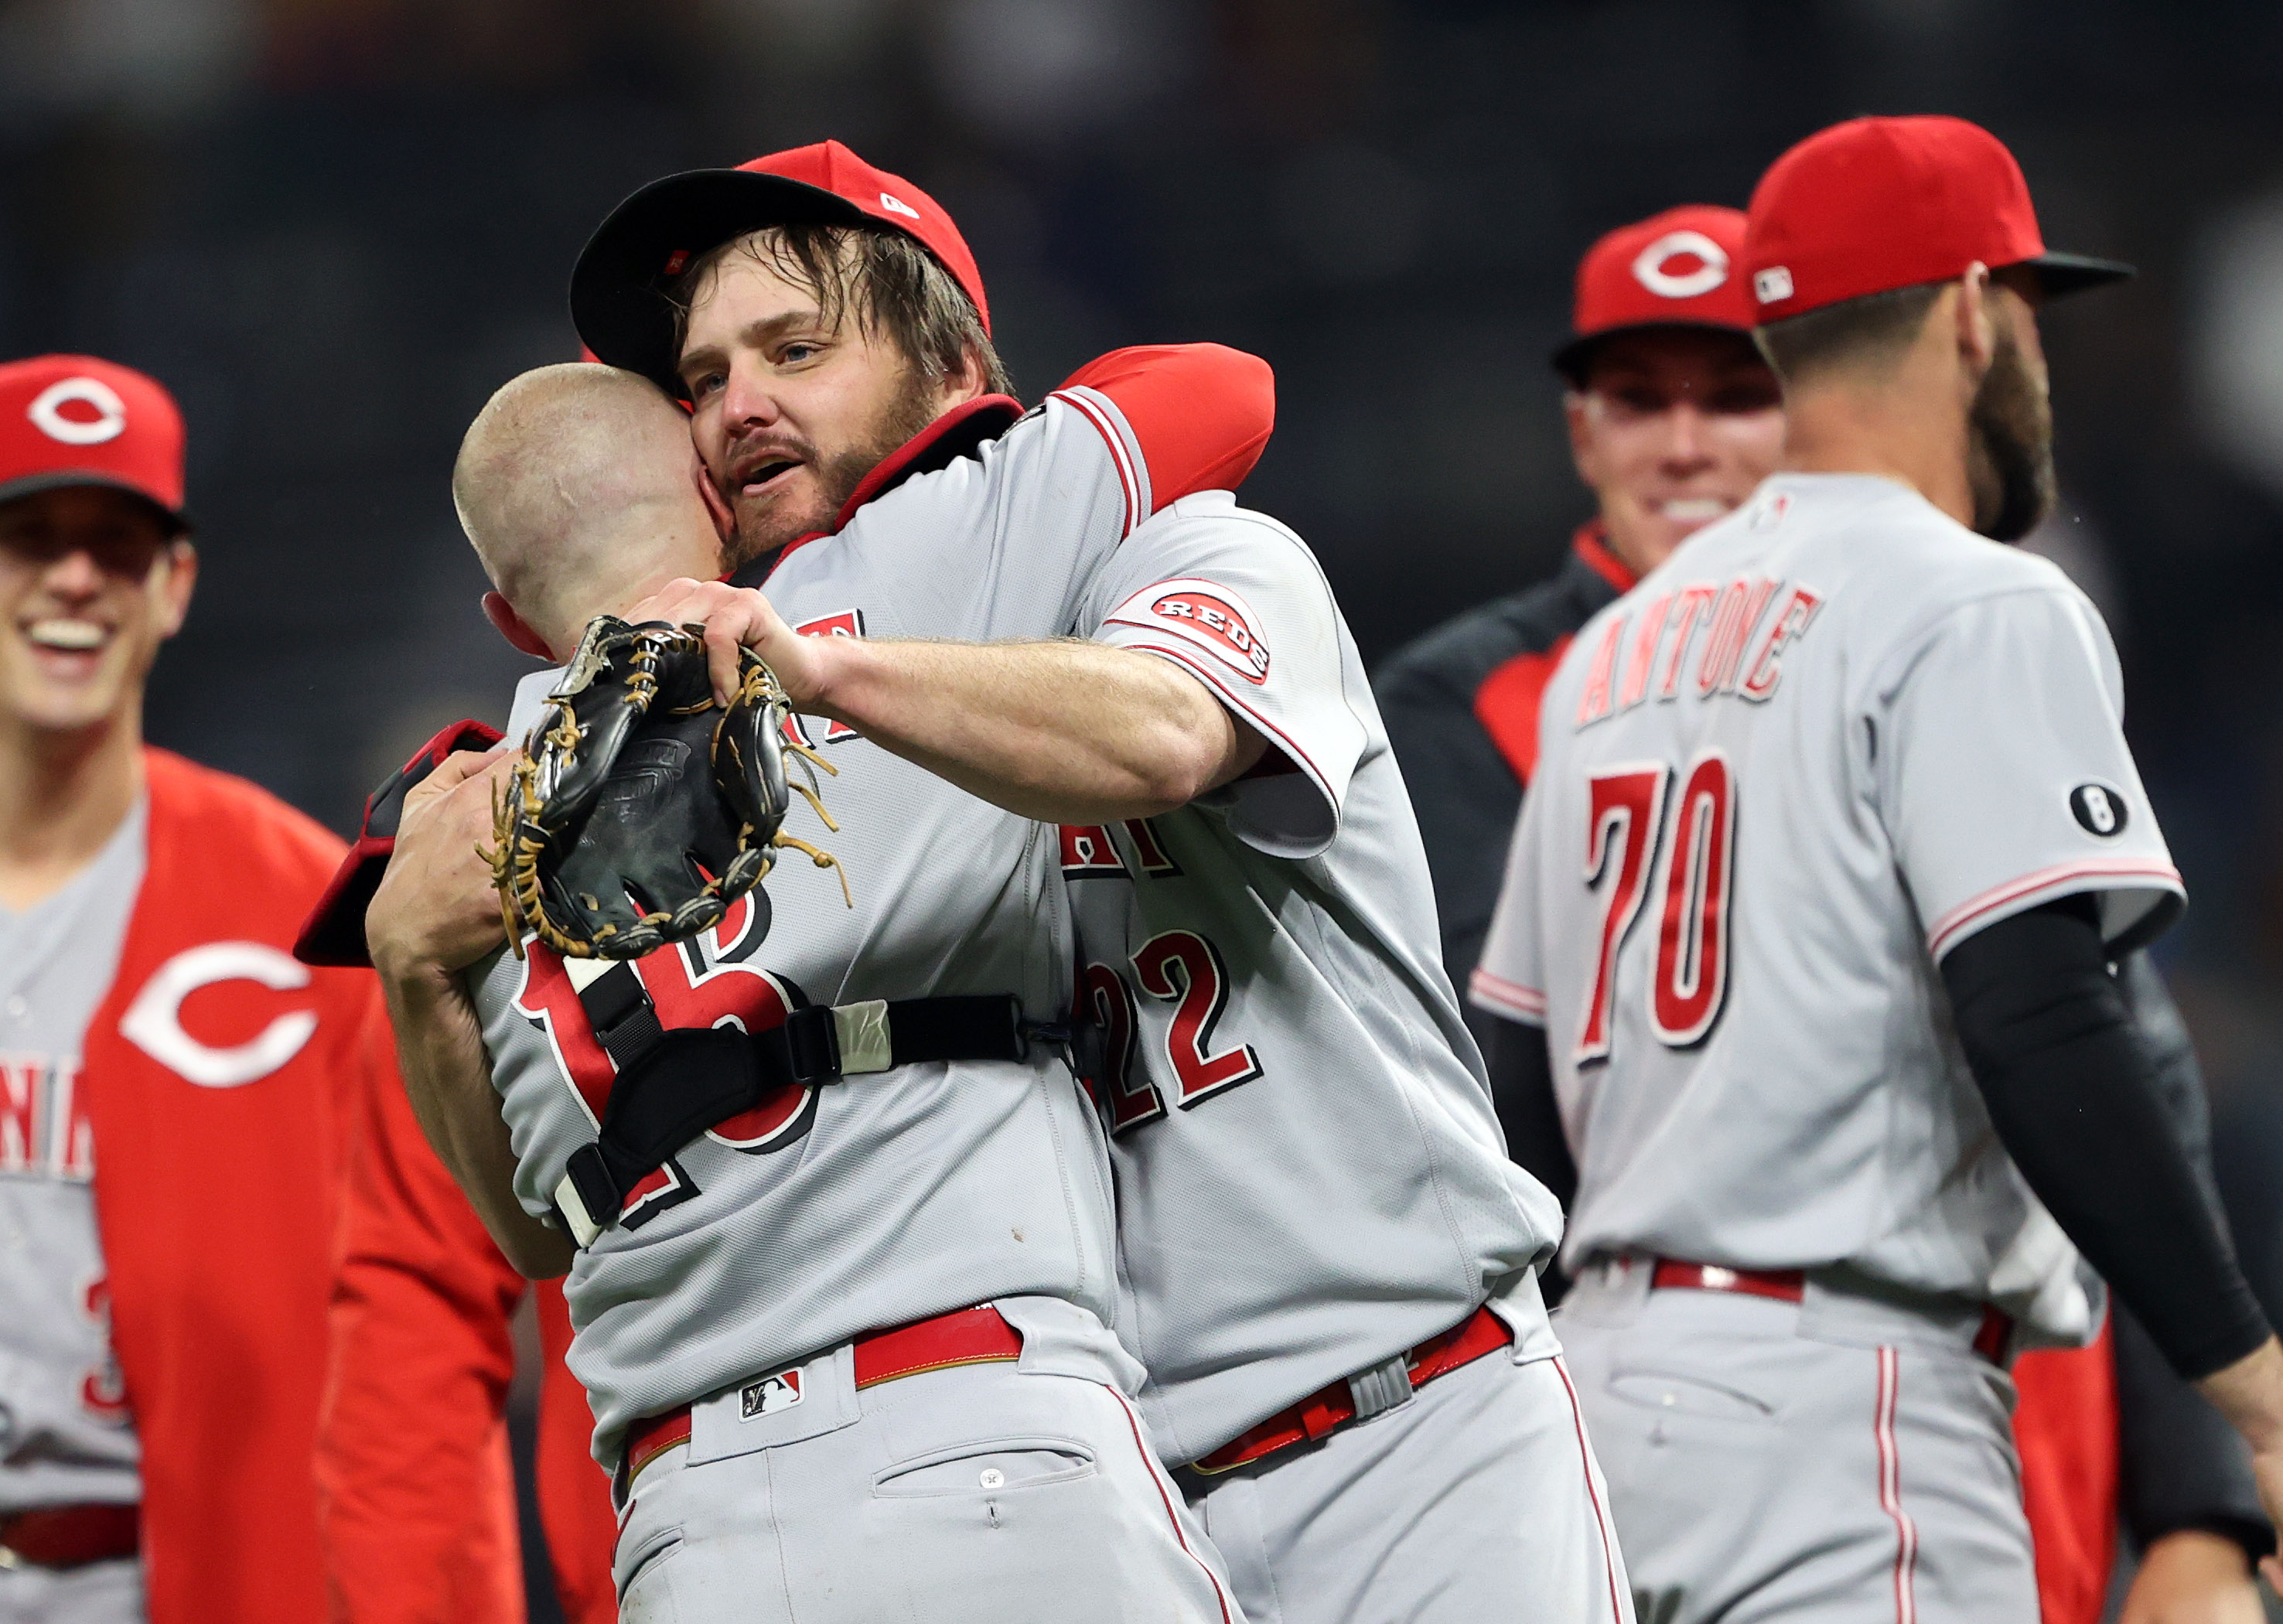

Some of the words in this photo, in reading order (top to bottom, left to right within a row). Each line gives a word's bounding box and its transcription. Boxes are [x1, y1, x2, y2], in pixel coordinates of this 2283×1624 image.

[1632, 230, 1731, 299] C
[27, 376, 126, 445] C
[1159, 600, 1271, 673] REDS
[1573, 747, 1739, 1070] 70
[118, 940, 319, 1089] C
[1073, 929, 1264, 1137] 22
